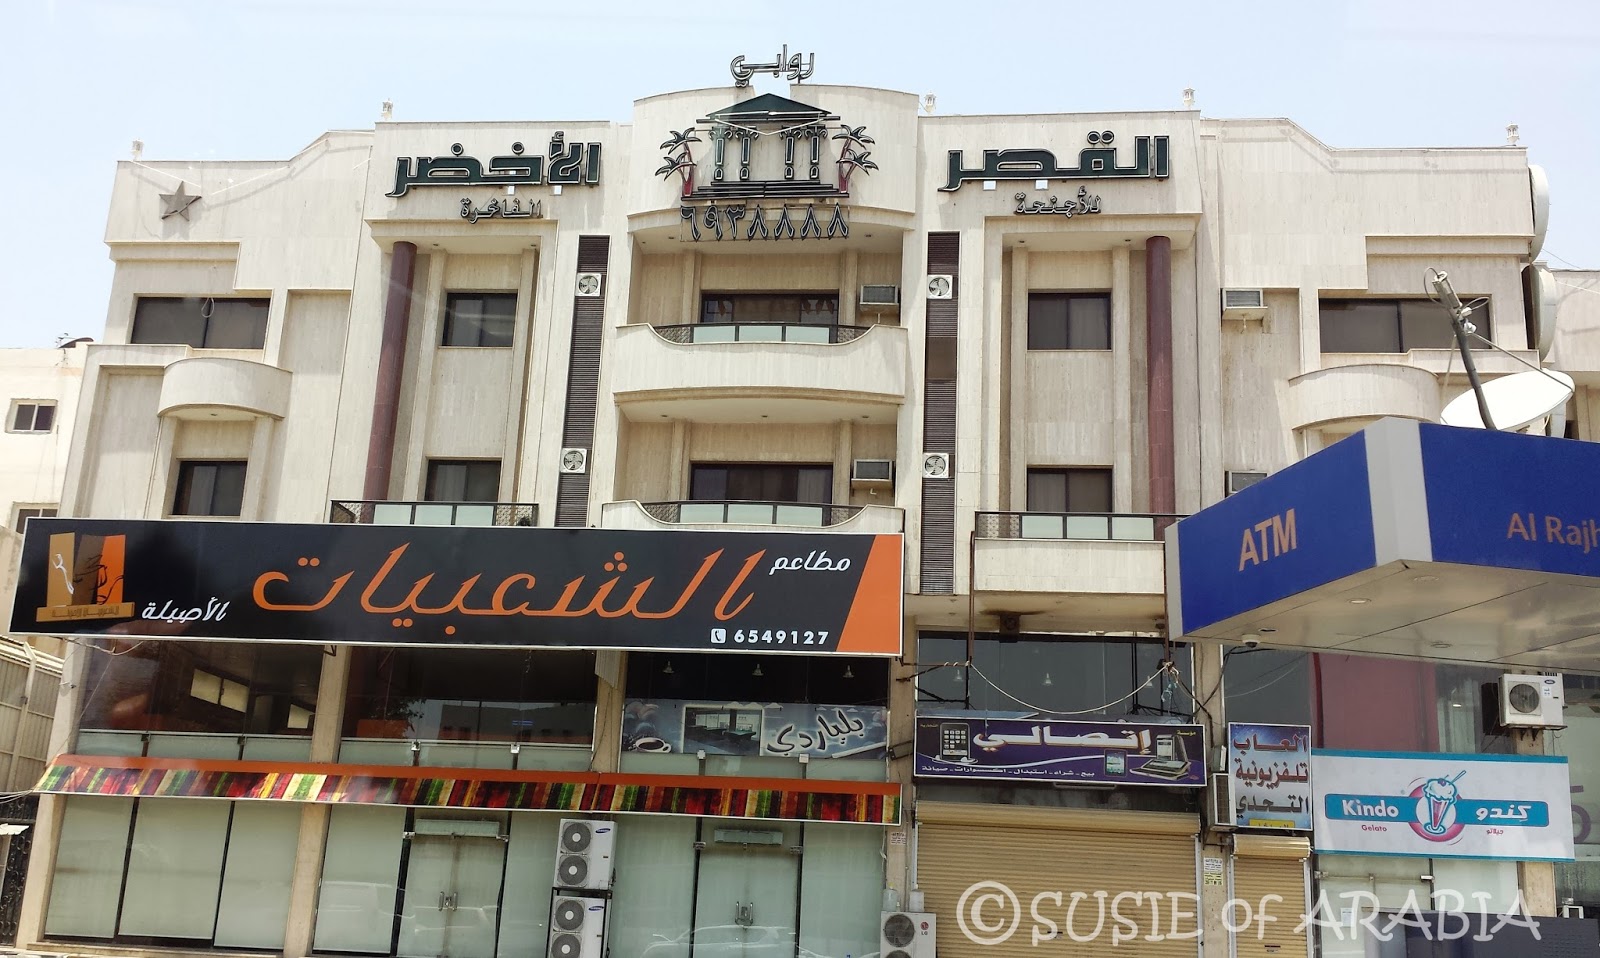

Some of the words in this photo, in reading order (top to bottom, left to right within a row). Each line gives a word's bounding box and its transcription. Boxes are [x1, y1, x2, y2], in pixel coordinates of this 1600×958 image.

[730, 44, 815, 88] روابي
[385, 130, 601, 198] الأخضر
[937, 130, 1170, 192] القصر
[460, 197, 544, 224] الفاخرة
[1014, 185, 1102, 219] للأجنحة
[1237, 508, 1297, 572] ATM
[1507, 512, 1537, 541] Al
[768, 548, 851, 575] مطاعم
[252, 542, 767, 636] الشعبيات
[141, 596, 230, 624] الأصيلة
[734, 628, 829, 645] 6549127
[1234, 757, 1309, 789] تلفزيونية
[1235, 794, 1309, 819] التحدي
[1342, 799, 1399, 818] Kindo
[1475, 804, 1532, 822] كندو
[1361, 824, 1388, 832] Gelato
